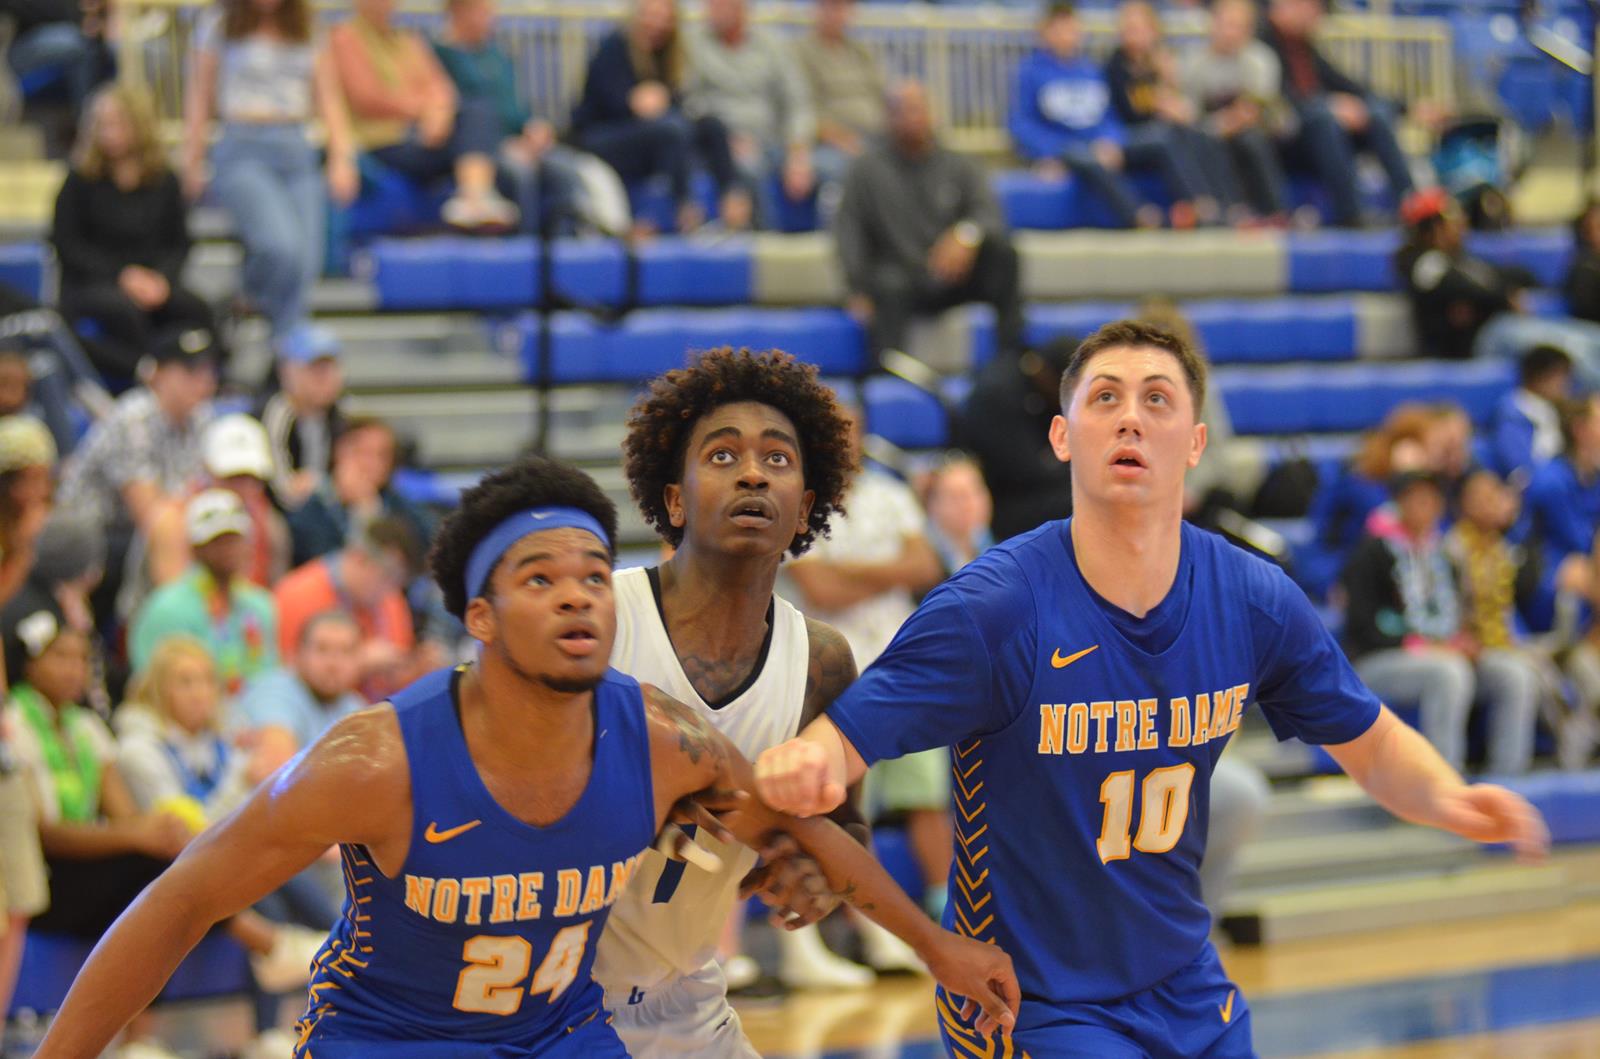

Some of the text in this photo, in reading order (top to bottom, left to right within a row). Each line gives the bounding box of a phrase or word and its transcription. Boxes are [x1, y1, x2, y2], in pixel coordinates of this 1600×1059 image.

[1038, 683, 1250, 755] NOTRE DAME
[1096, 762, 1195, 865] 10
[404, 872, 544, 925] NOTRE
[452, 920, 593, 1016] 24
